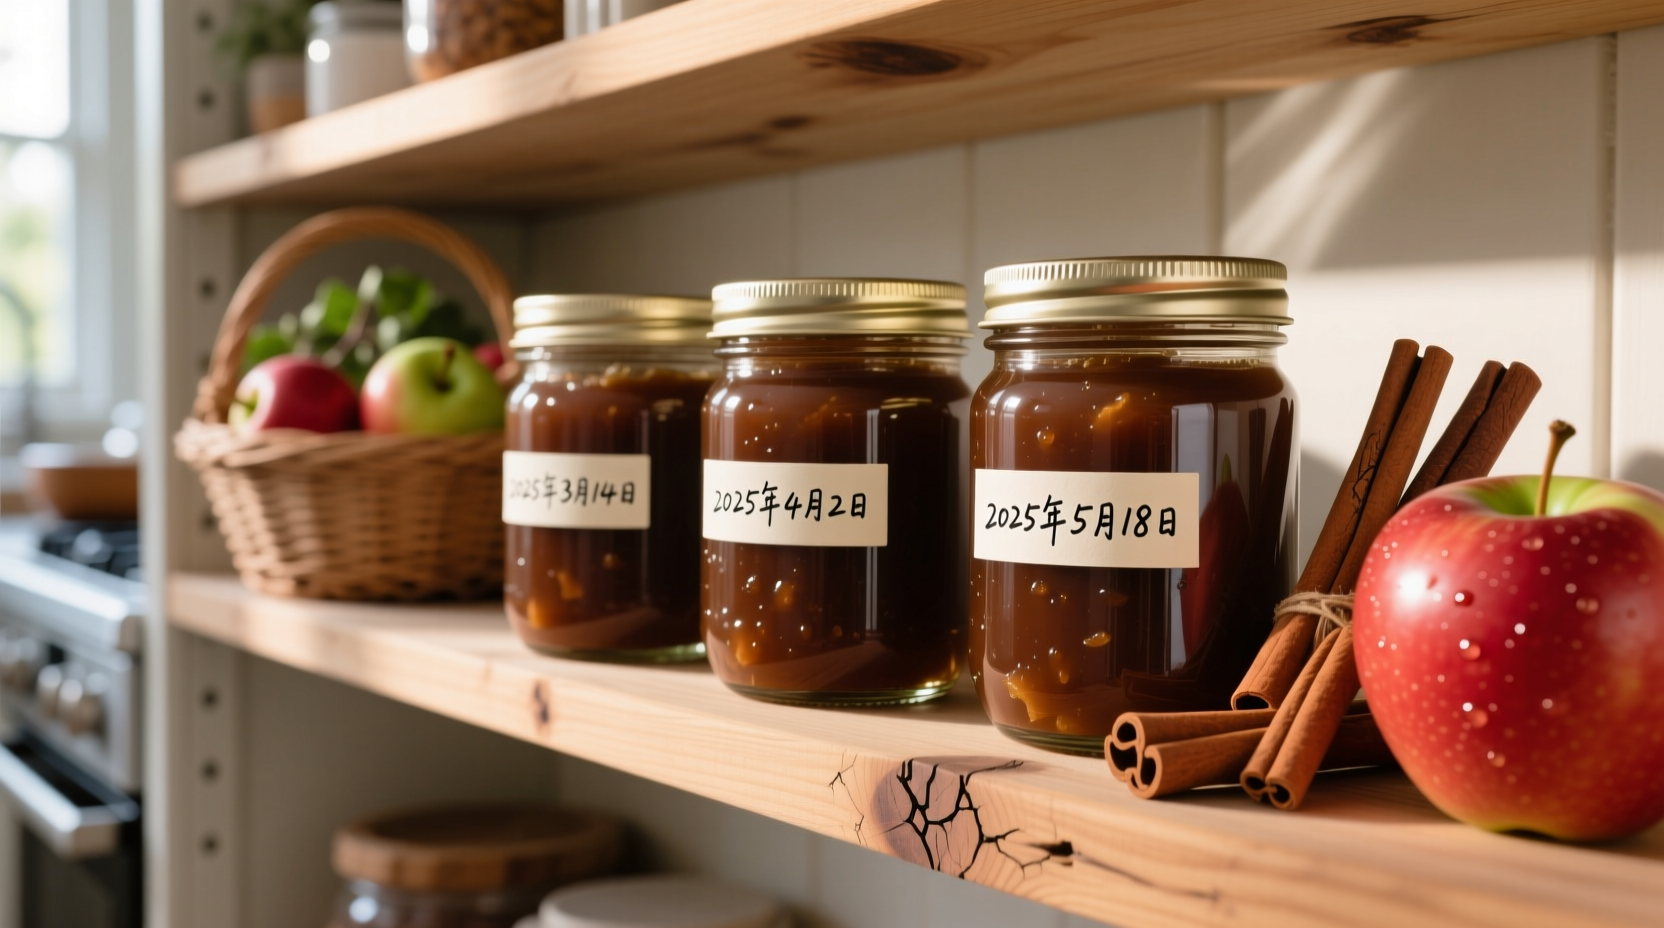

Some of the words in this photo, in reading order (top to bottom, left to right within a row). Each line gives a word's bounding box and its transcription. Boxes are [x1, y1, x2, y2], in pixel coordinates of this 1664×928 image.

[713, 480, 867, 527] 2025年4月2日
[985, 494, 1176, 546] 2025年5月18日
